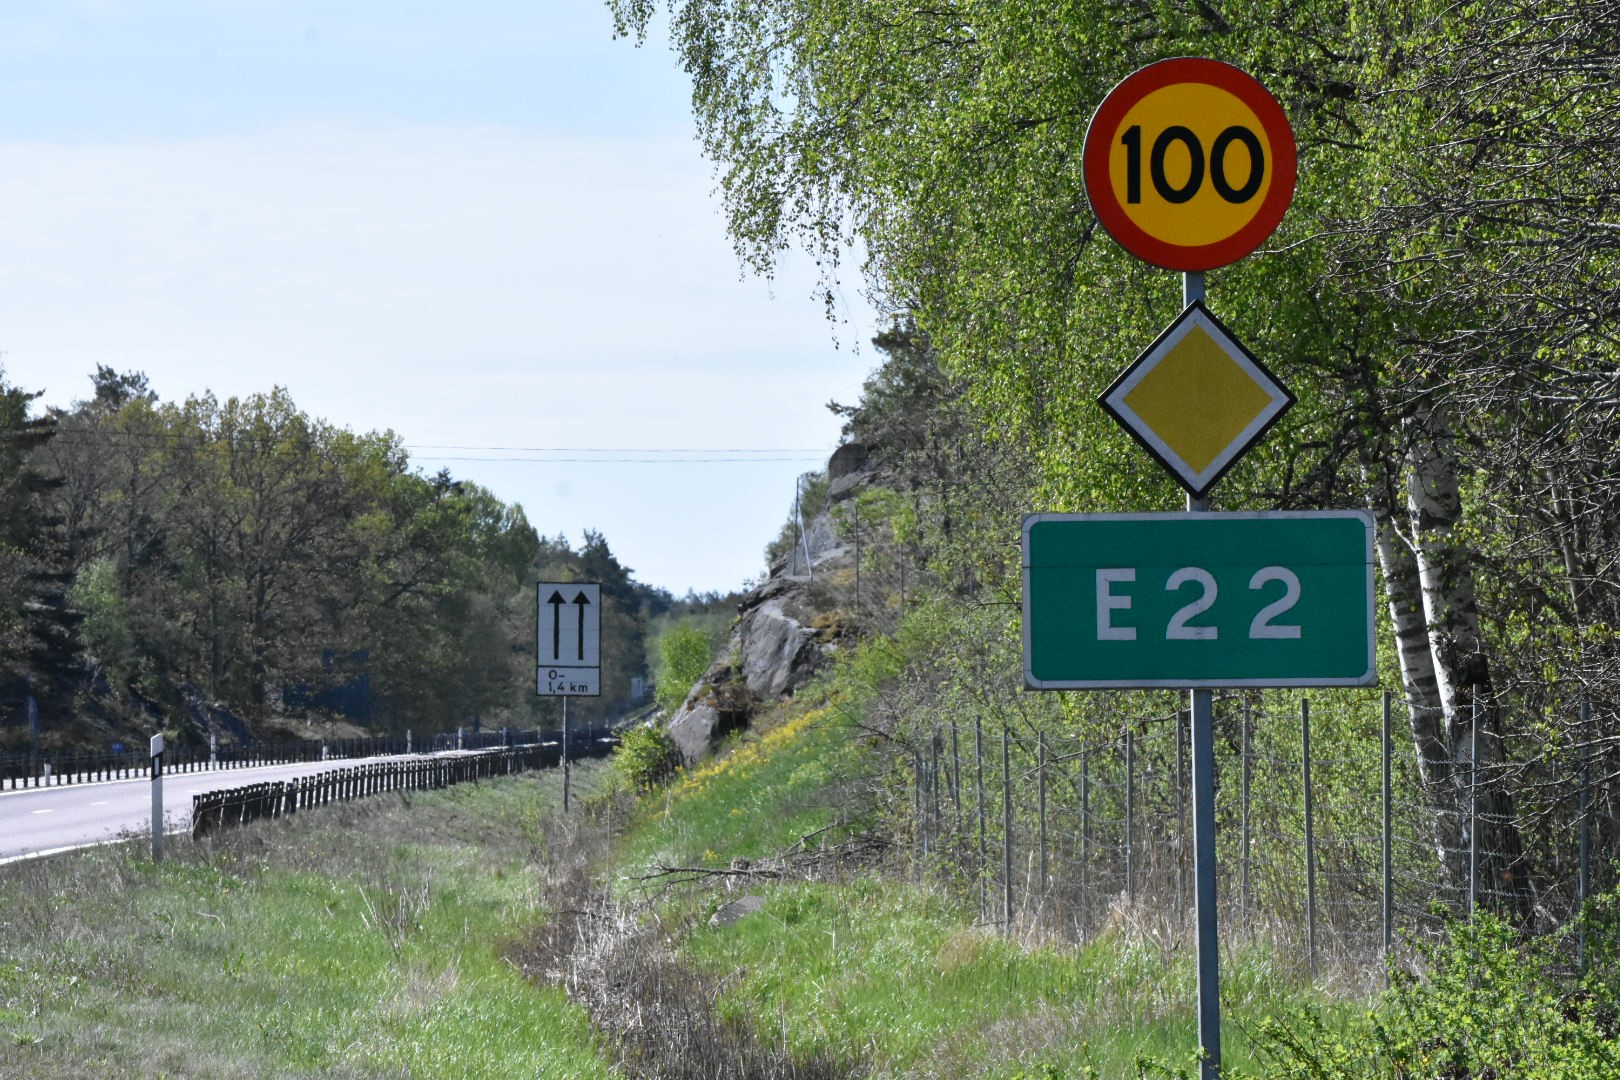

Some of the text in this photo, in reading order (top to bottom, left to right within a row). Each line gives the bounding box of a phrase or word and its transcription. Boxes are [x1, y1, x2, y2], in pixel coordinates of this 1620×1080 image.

[1121, 125, 1265, 204] 100
[548, 682, 588, 694] 1,4 km
